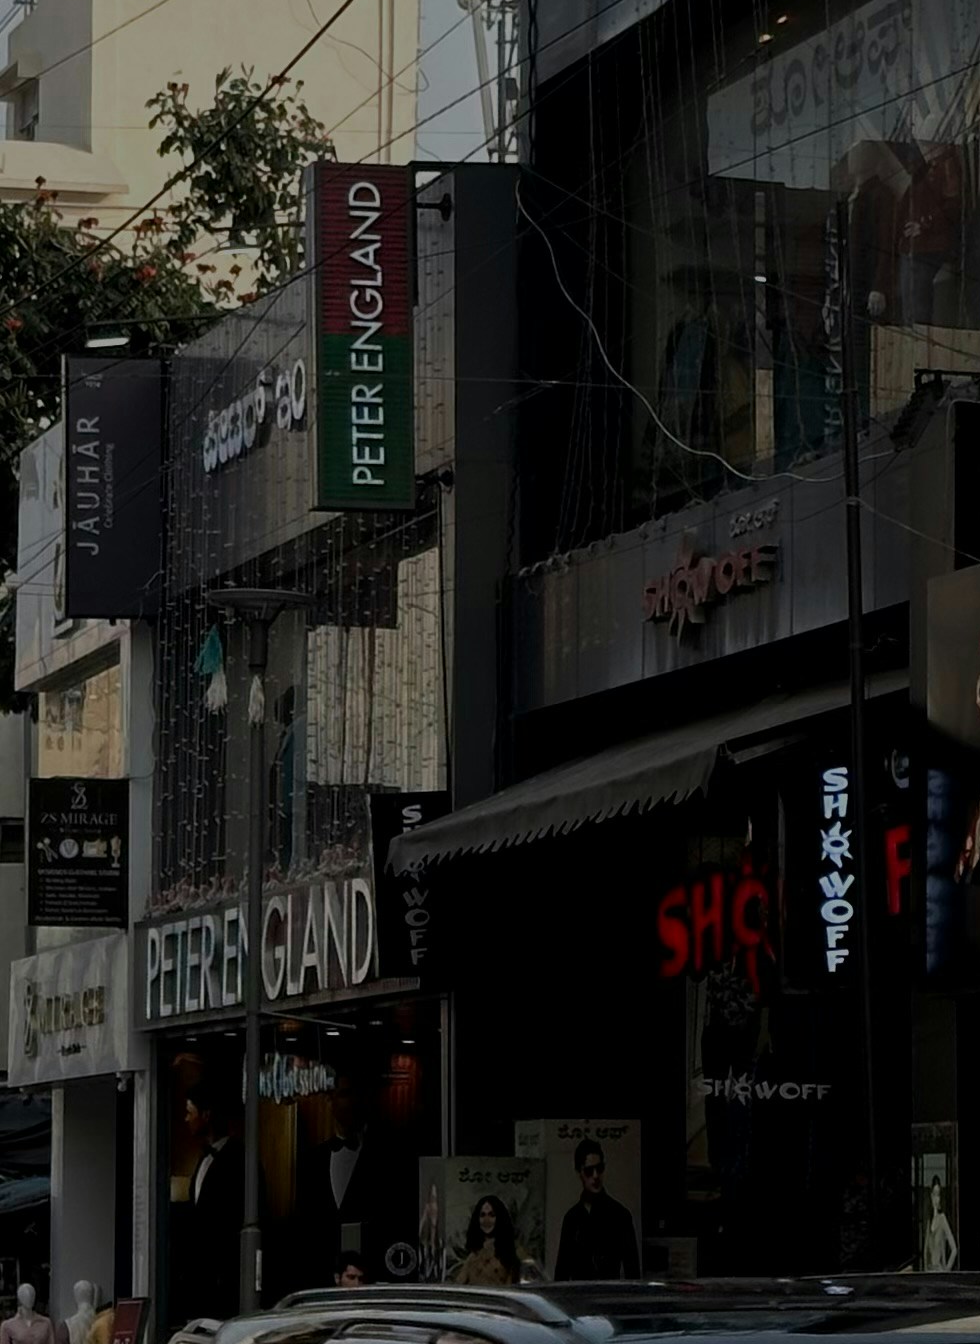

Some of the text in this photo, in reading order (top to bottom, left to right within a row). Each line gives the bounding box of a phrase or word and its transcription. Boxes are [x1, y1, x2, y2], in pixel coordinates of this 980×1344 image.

[347, 180, 386, 488] PETER ENGLAND
[640, 530, 780, 644] SHOWOFF
[59, 811, 119, 826] MIRAGE
[816, 765, 856, 973] SHOWOFF
[401, 803, 432, 966] SOWOFF
[145, 916, 218, 1020] PETER
[703, 1069, 833, 1107] SHOWOFF
